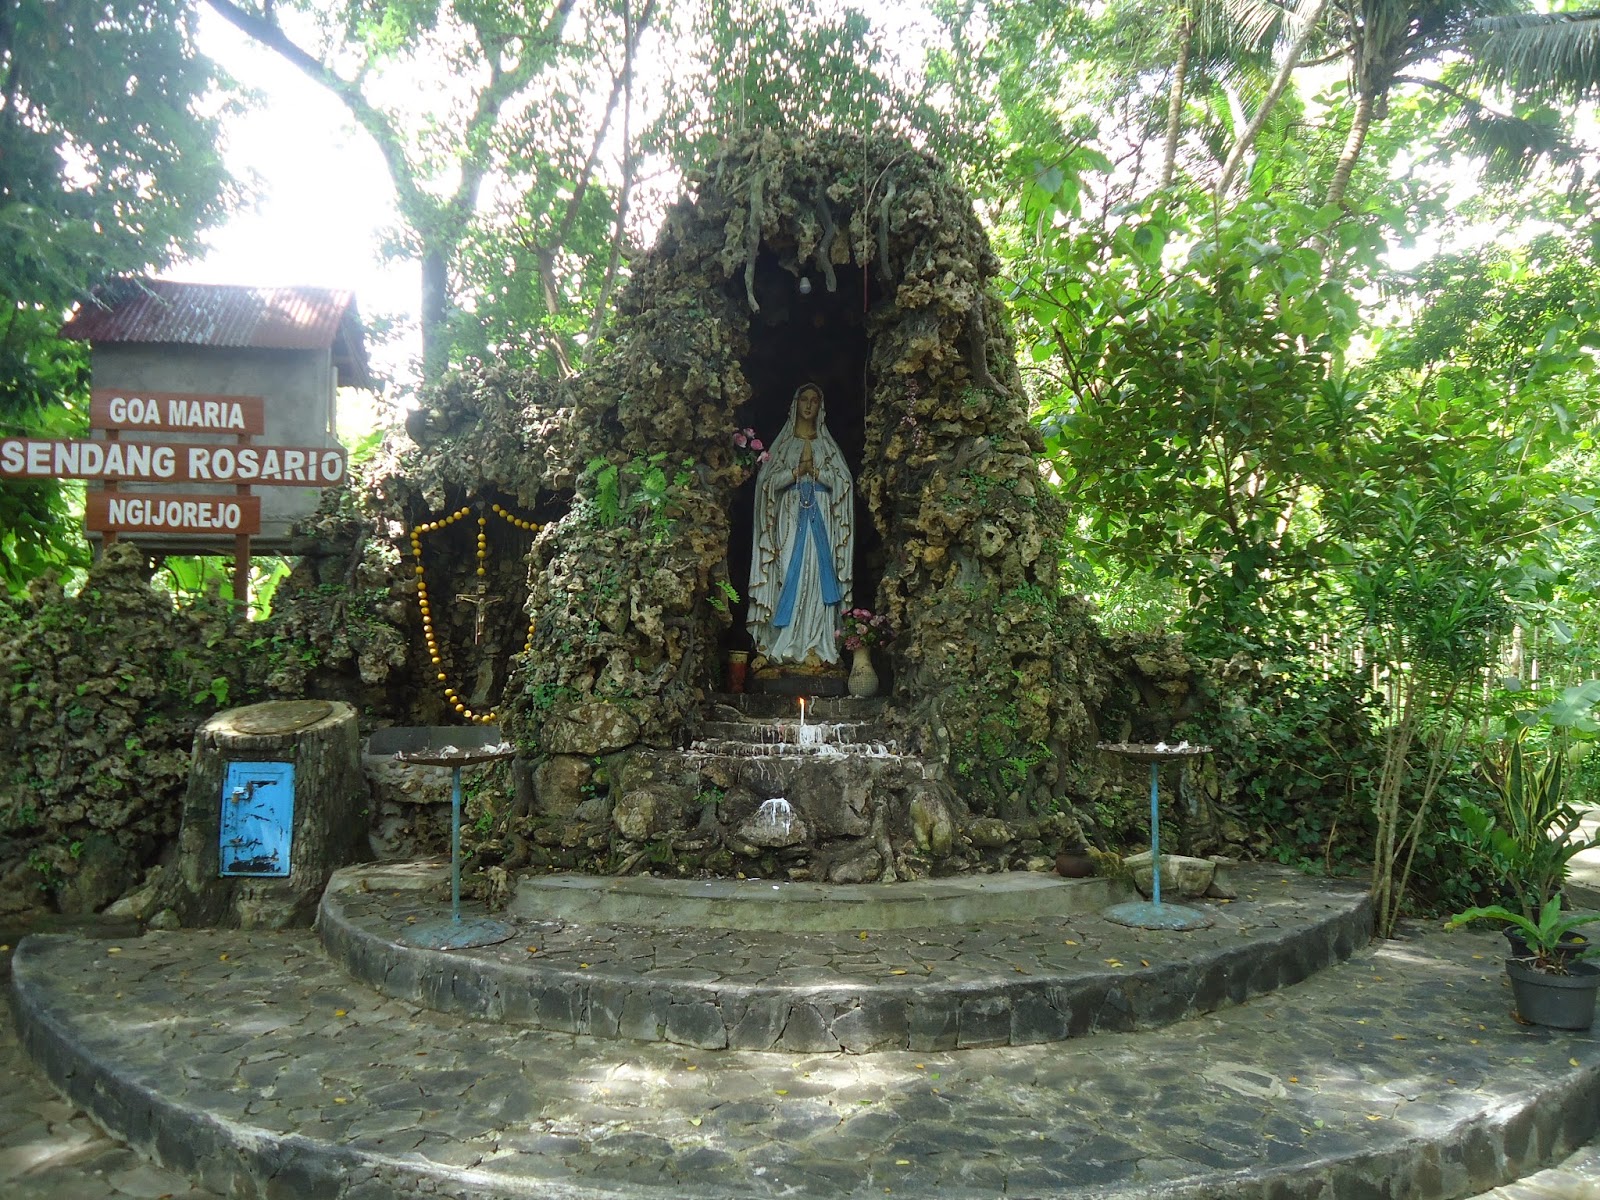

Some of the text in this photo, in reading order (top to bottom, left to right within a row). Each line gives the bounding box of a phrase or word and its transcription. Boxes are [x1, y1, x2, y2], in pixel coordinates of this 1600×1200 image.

[109, 397, 245, 429] GOA MARIA
[1, 440, 343, 481] SENDANG ROSARIO
[108, 498, 241, 529] NGIJOREJO
